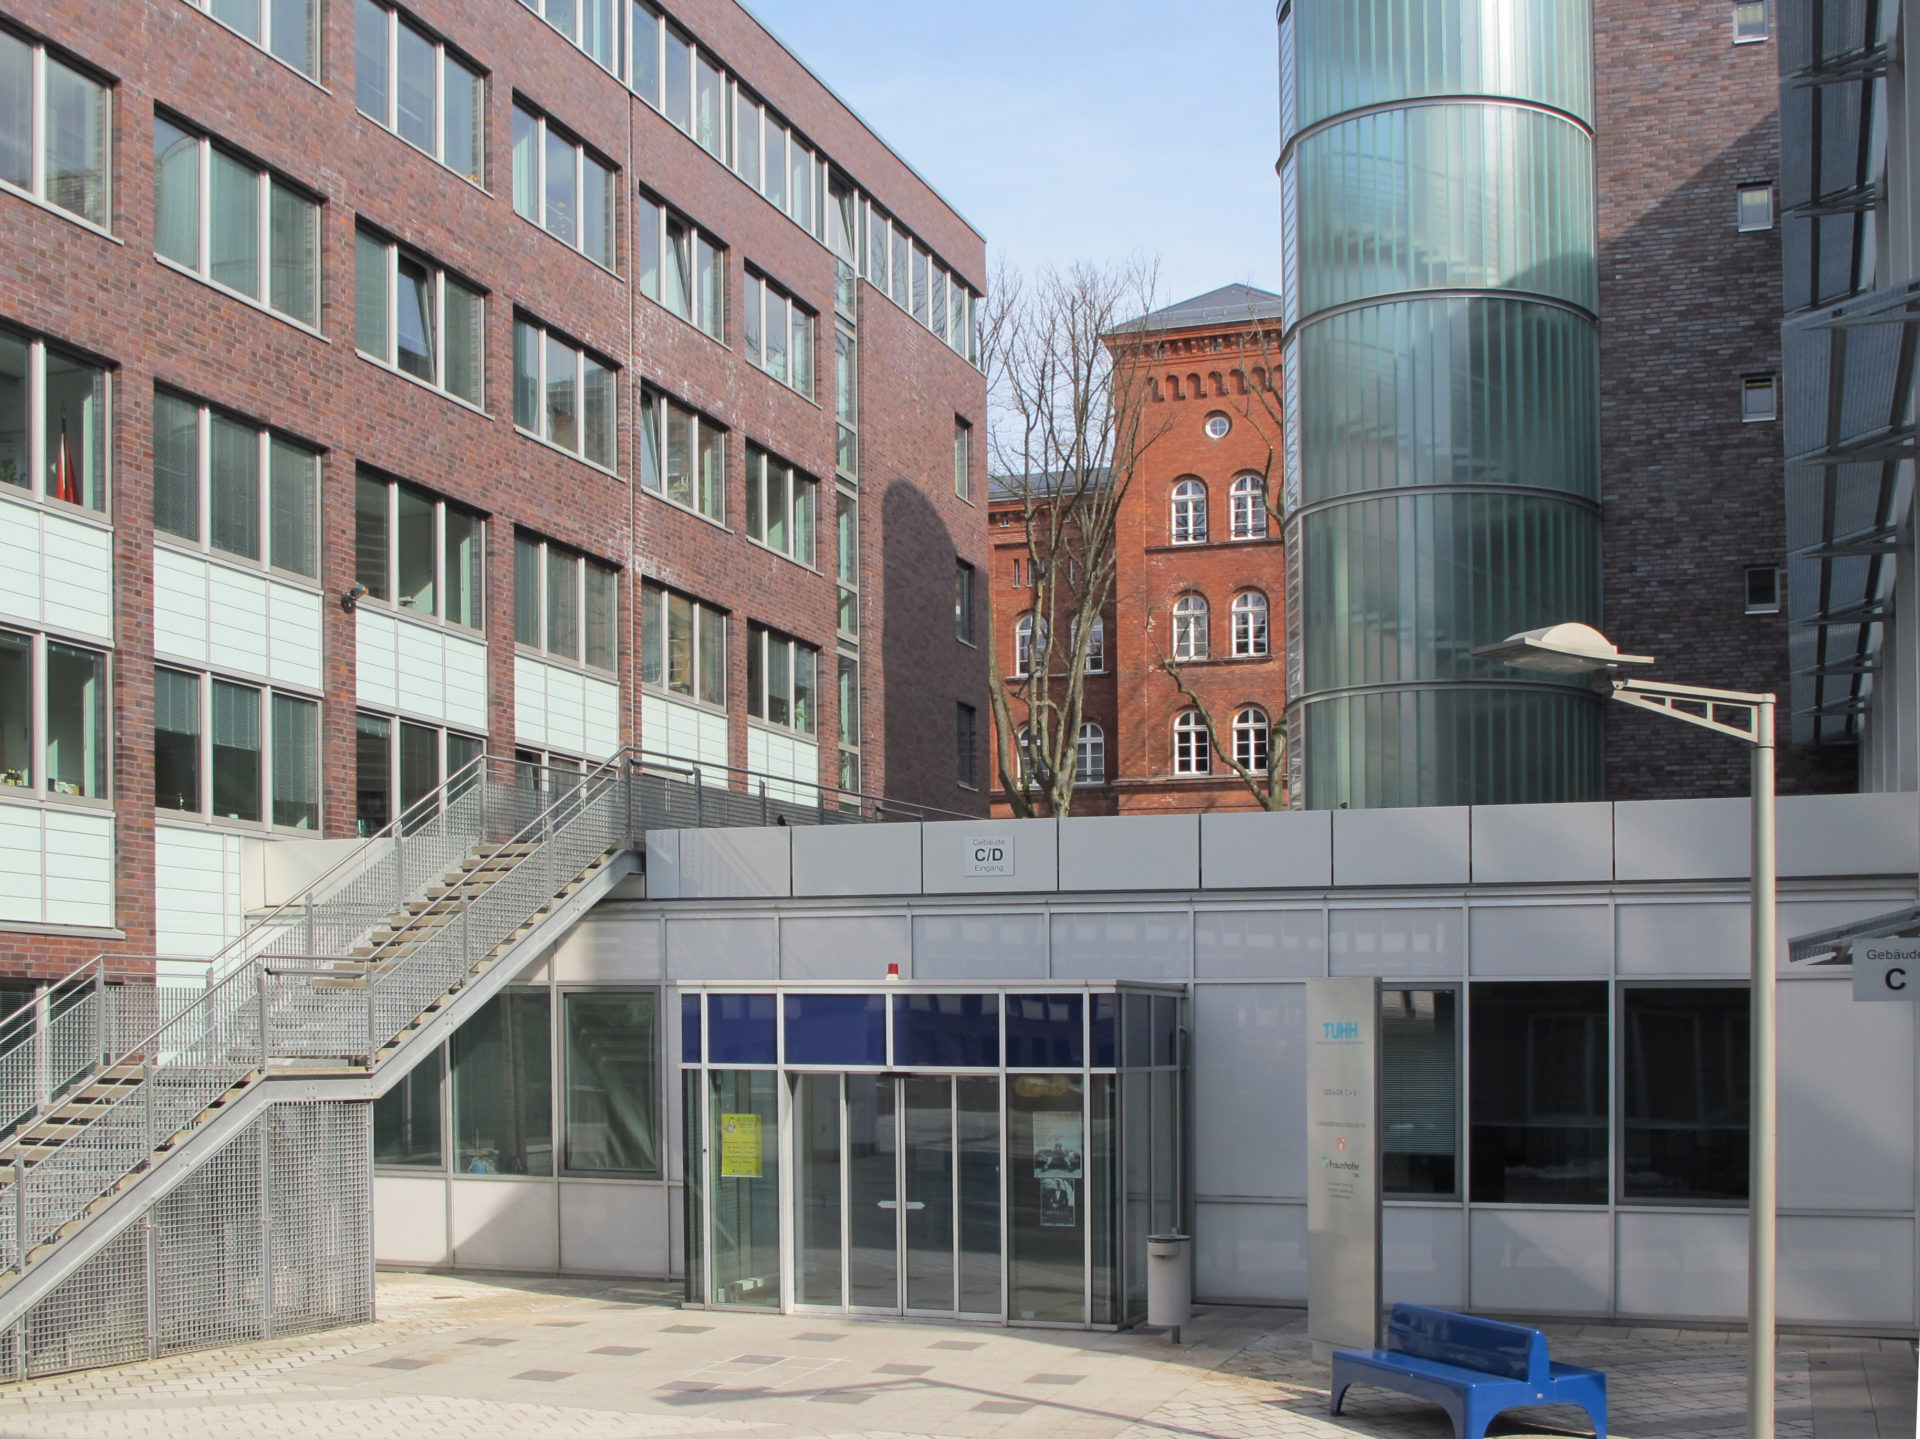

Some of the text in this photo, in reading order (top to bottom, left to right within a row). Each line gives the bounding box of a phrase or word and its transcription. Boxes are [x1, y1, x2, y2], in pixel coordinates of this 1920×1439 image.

[975, 848, 1003, 861] C/D
[1885, 968, 1906, 990] C
[1322, 1021, 1358, 1039] TUHH
